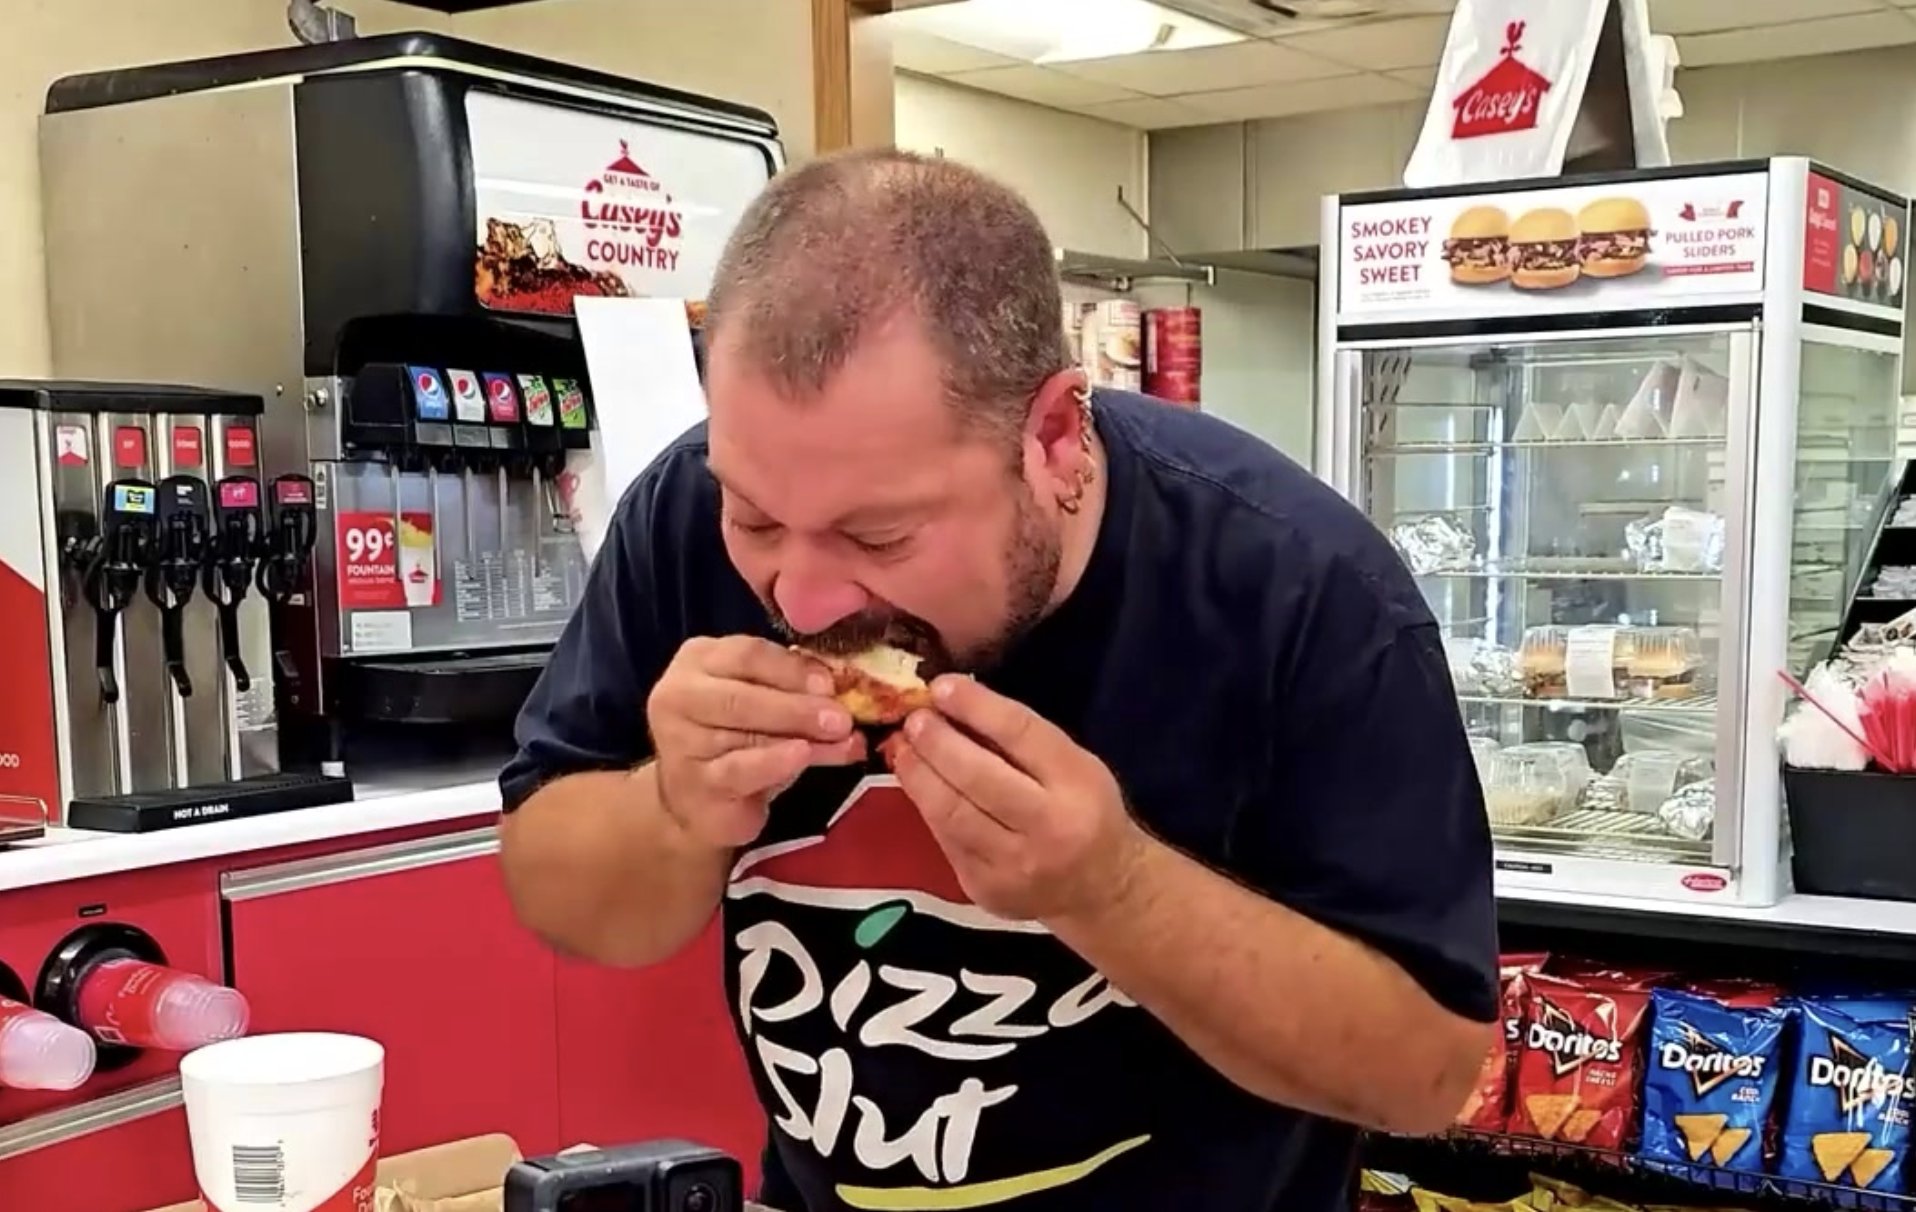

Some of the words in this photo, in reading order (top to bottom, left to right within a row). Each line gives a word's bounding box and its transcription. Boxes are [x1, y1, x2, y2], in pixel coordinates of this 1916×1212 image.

[1462, 85, 1537, 124] Casey's
[1351, 216, 1432, 239] SMOKEY
[1665, 229, 1715, 244] PULLED
[1718, 226, 1755, 240] PORK
[587, 239, 679, 271] COUNTRY
[1353, 240, 1429, 262] SAVORY
[1683, 244, 1736, 258] SLIDERS
[1360, 264, 1422, 285] SWEET
[346, 563, 396, 577] FOUNTAIN
[173, 807, 193, 820] NOT
[193, 806, 201, 817] A
[201, 803, 229, 816] DRAIN
[1528, 1021, 1624, 1061] Doritos
[1662, 1043, 1765, 1077] Doritos
[1811, 1056, 1916, 1099] Doritos
[755, 1033, 1019, 1183] Slut
